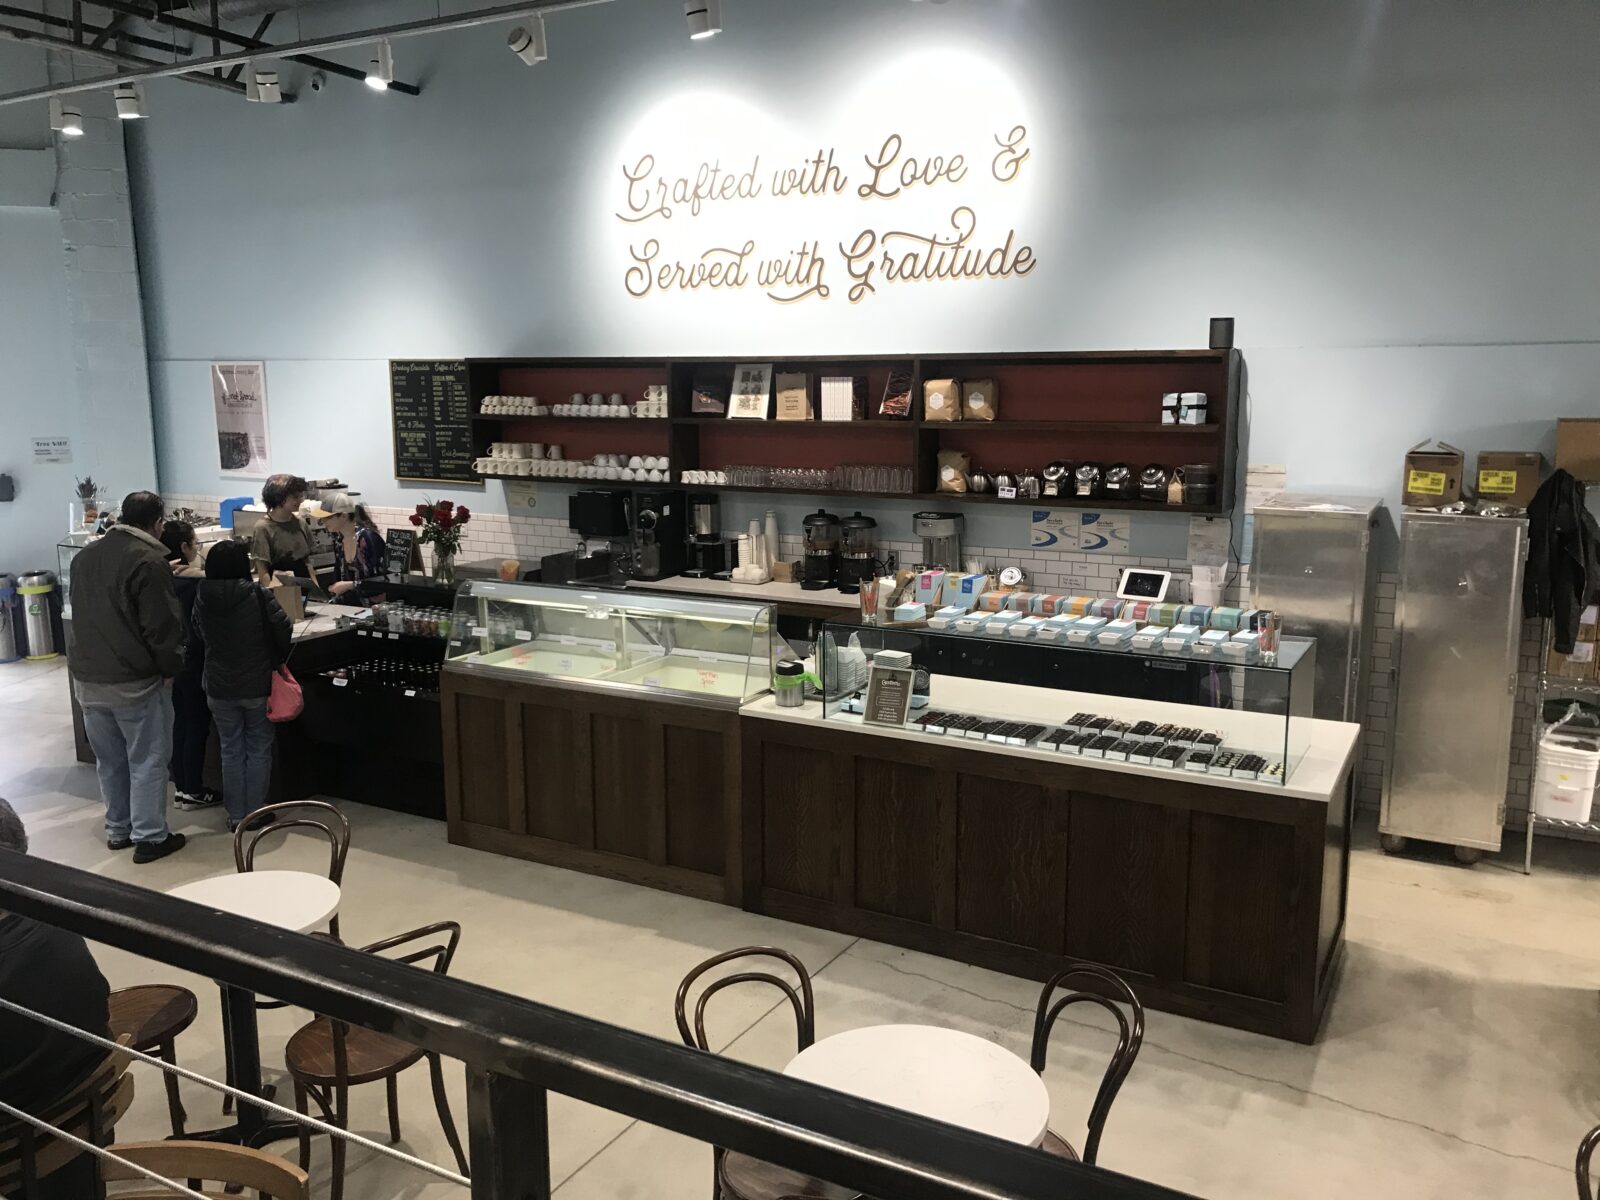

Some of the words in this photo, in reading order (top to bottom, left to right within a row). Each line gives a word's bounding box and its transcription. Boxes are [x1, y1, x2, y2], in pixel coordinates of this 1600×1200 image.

[615, 153, 762, 224] Crafted
[772, 147, 849, 198] with
[857, 132, 969, 199] Love
[990, 124, 1031, 183] &
[623, 238, 755, 298] Served
[757, 239, 831, 304] with
[838, 205, 1037, 305] Gratitude
